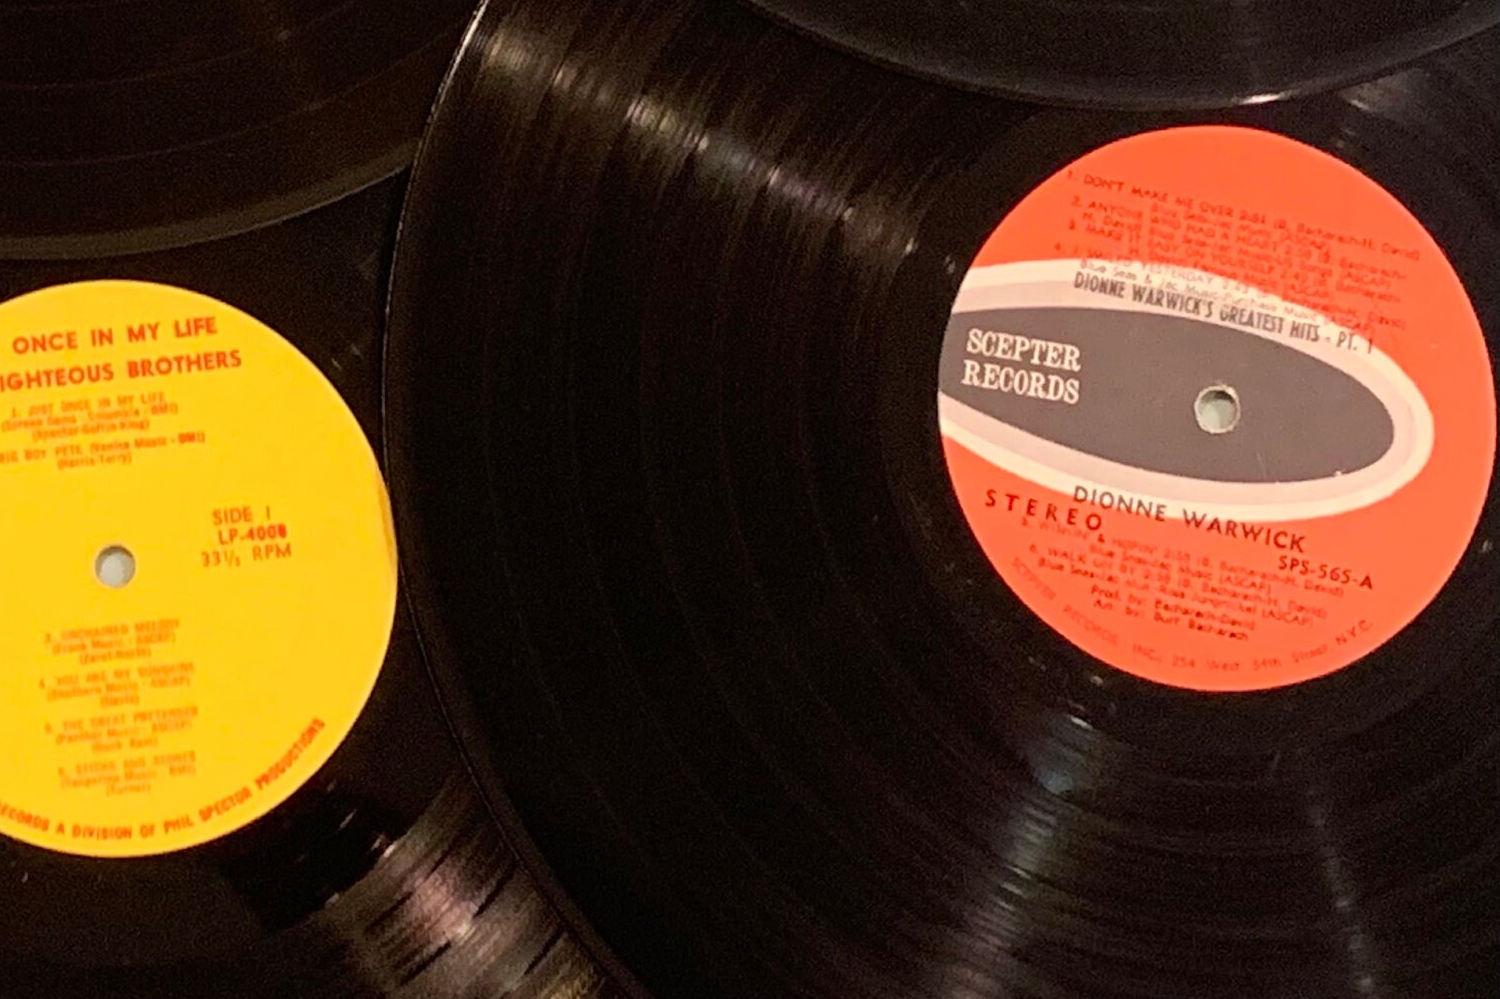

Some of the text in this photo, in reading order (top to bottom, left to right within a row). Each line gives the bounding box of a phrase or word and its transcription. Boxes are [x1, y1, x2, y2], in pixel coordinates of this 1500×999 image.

[1073, 270, 1126, 300] DIONNE
[1132, 282, 1215, 319] WARWICK'S
[1218, 305, 1285, 336] GREATEST
[1289, 318, 1322, 344] HITS
[11, 330, 78, 356] ONCE
[90, 327, 115, 347] IN
[126, 321, 162, 344] MY
[173, 315, 218, 339] LIFE
[965, 327, 1082, 373] SCEPTER
[126, 348, 243, 380] BROTHERS
[960, 358, 1081, 405] RECORDS
[211, 505, 254, 527] SIDE
[984, 488, 1105, 532] STEREO
[1072, 484, 1308, 554] DIONNE WARWICK
[251, 541, 293, 563] RPM
[1277, 554, 1375, 591] SPS-565-A
[56, 823, 66, 837] A
[71, 823, 134, 841] DIVISION
[139, 823, 156, 839] OF
[163, 815, 195, 836] PHIL
[198, 784, 253, 824] SPECTOR
[254, 715, 328, 790] PRODUCTIONS
